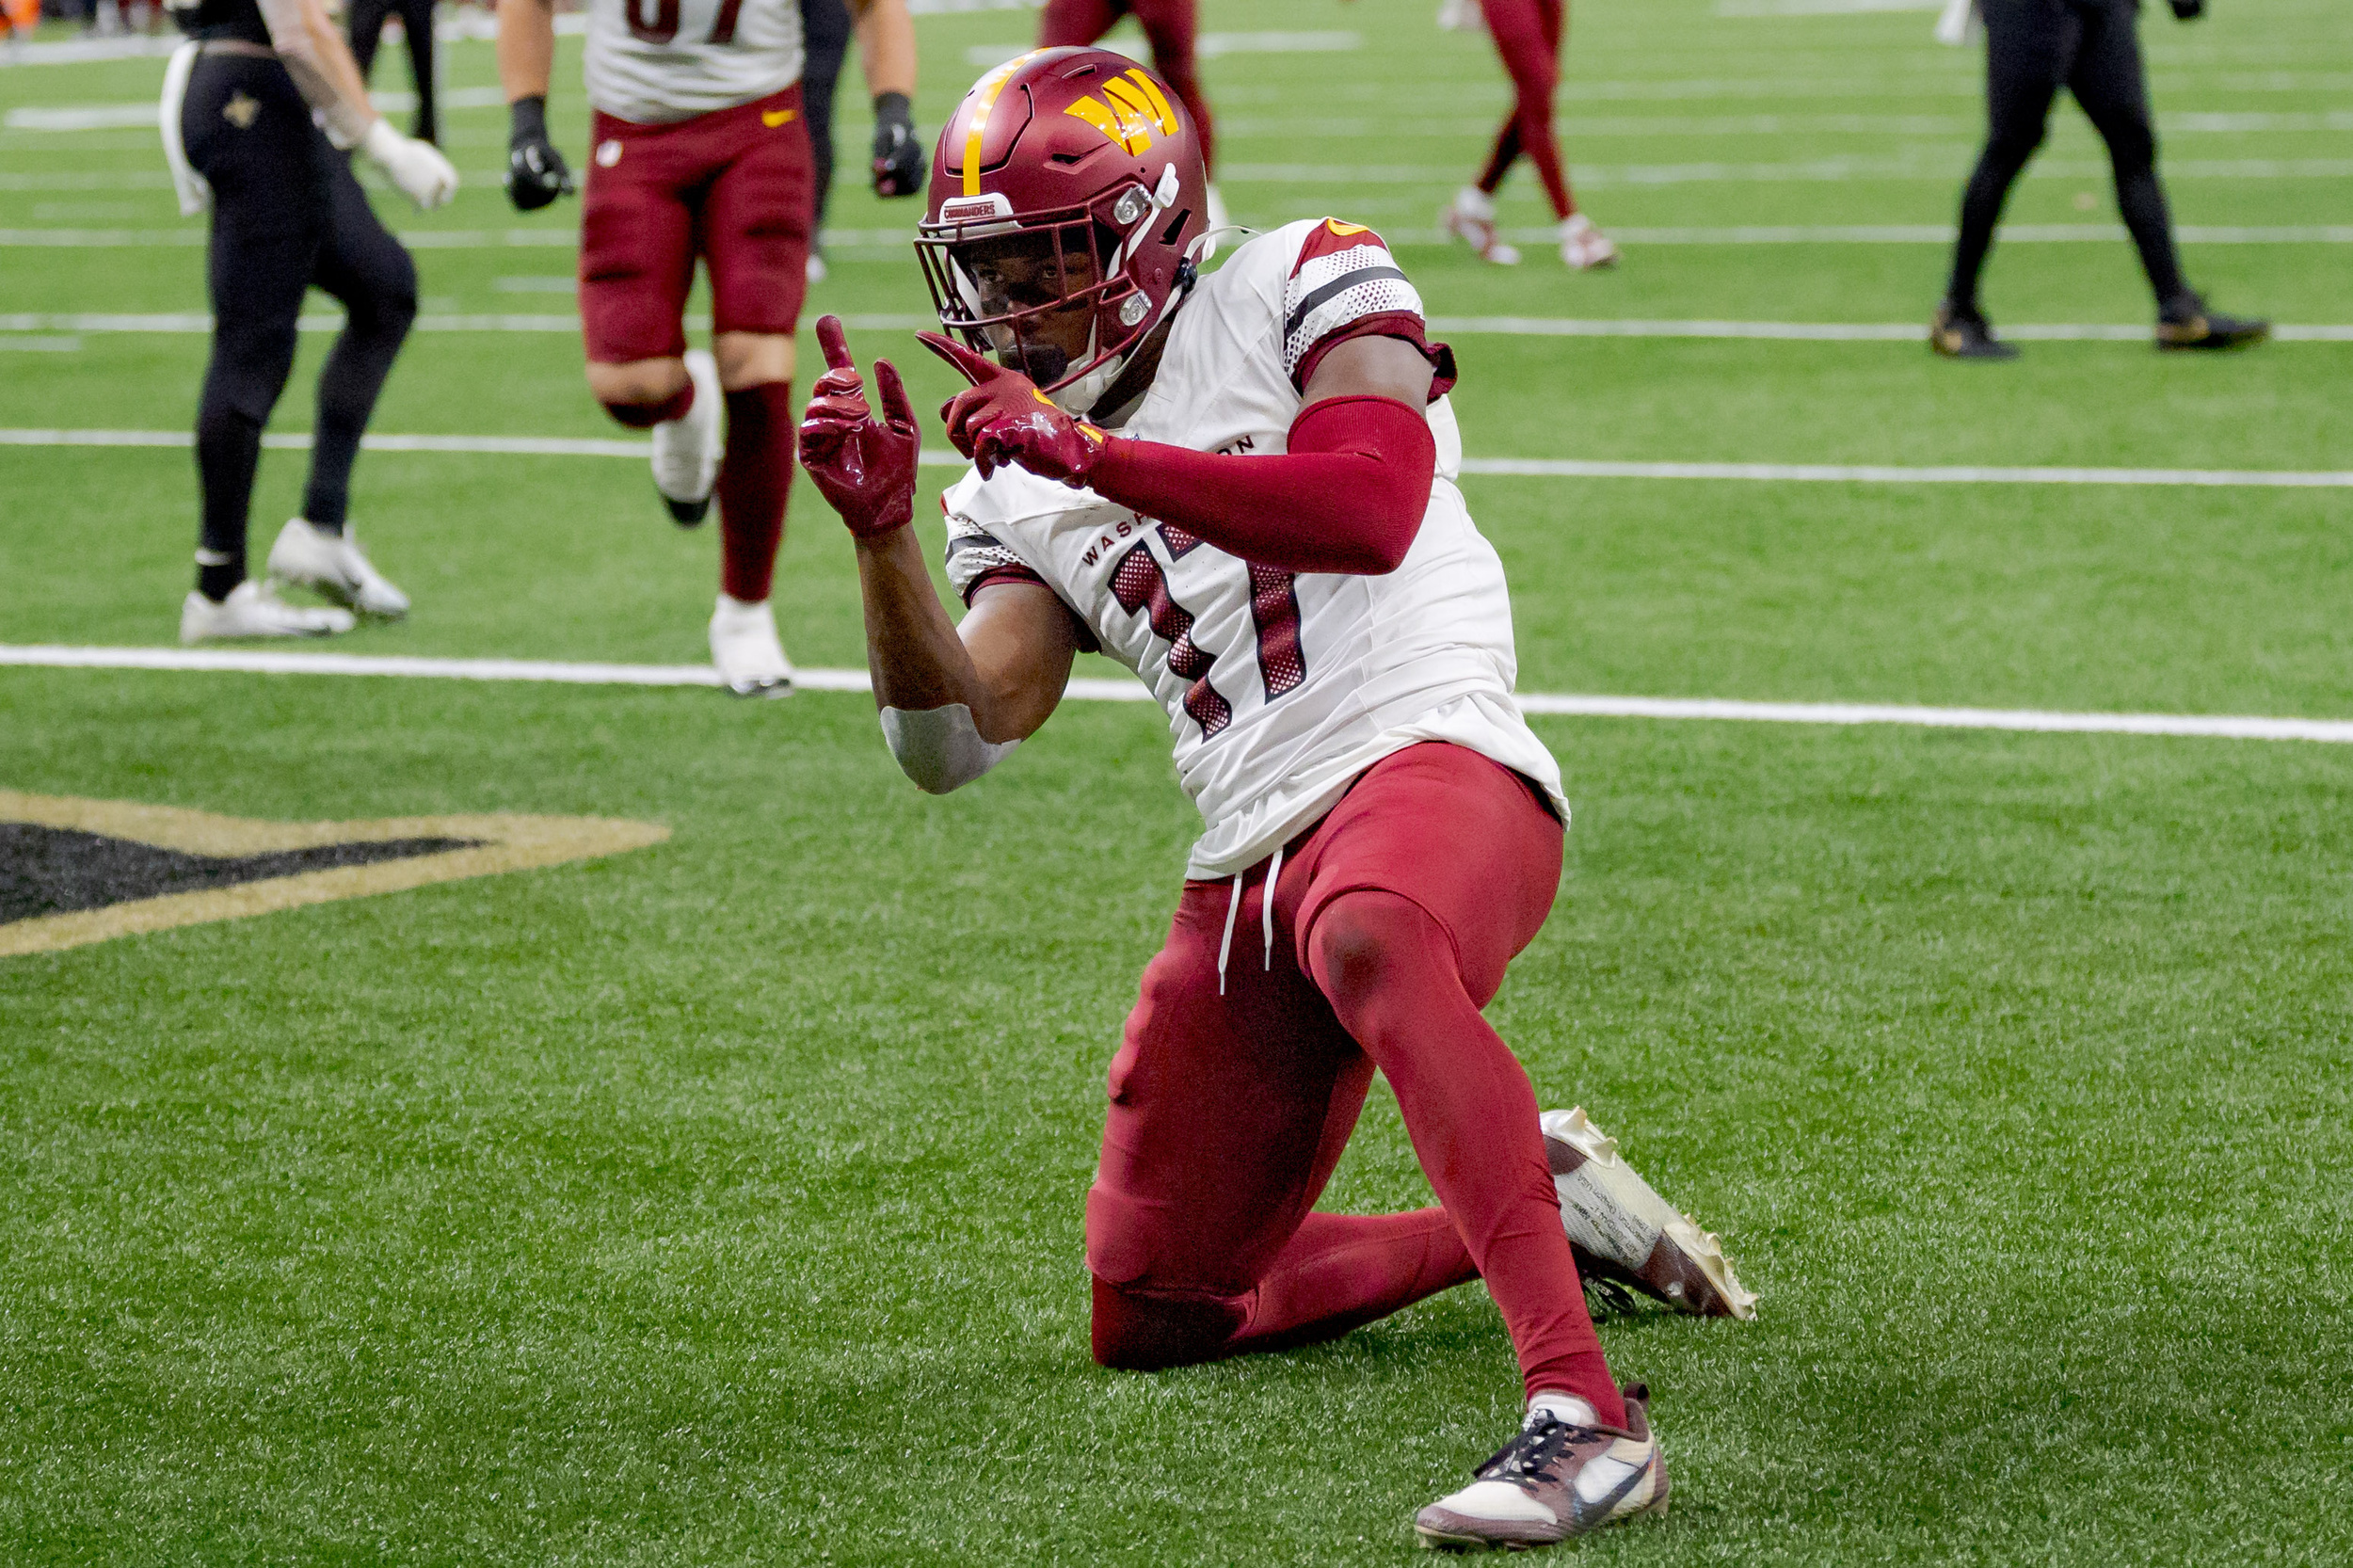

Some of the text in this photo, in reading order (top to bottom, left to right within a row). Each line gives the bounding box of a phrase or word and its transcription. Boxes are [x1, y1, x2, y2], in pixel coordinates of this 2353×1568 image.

[944, 204, 996, 219] COMMANDERS
[1108, 521, 1306, 744] 17
[1577, 1173, 1593, 1191] USA
